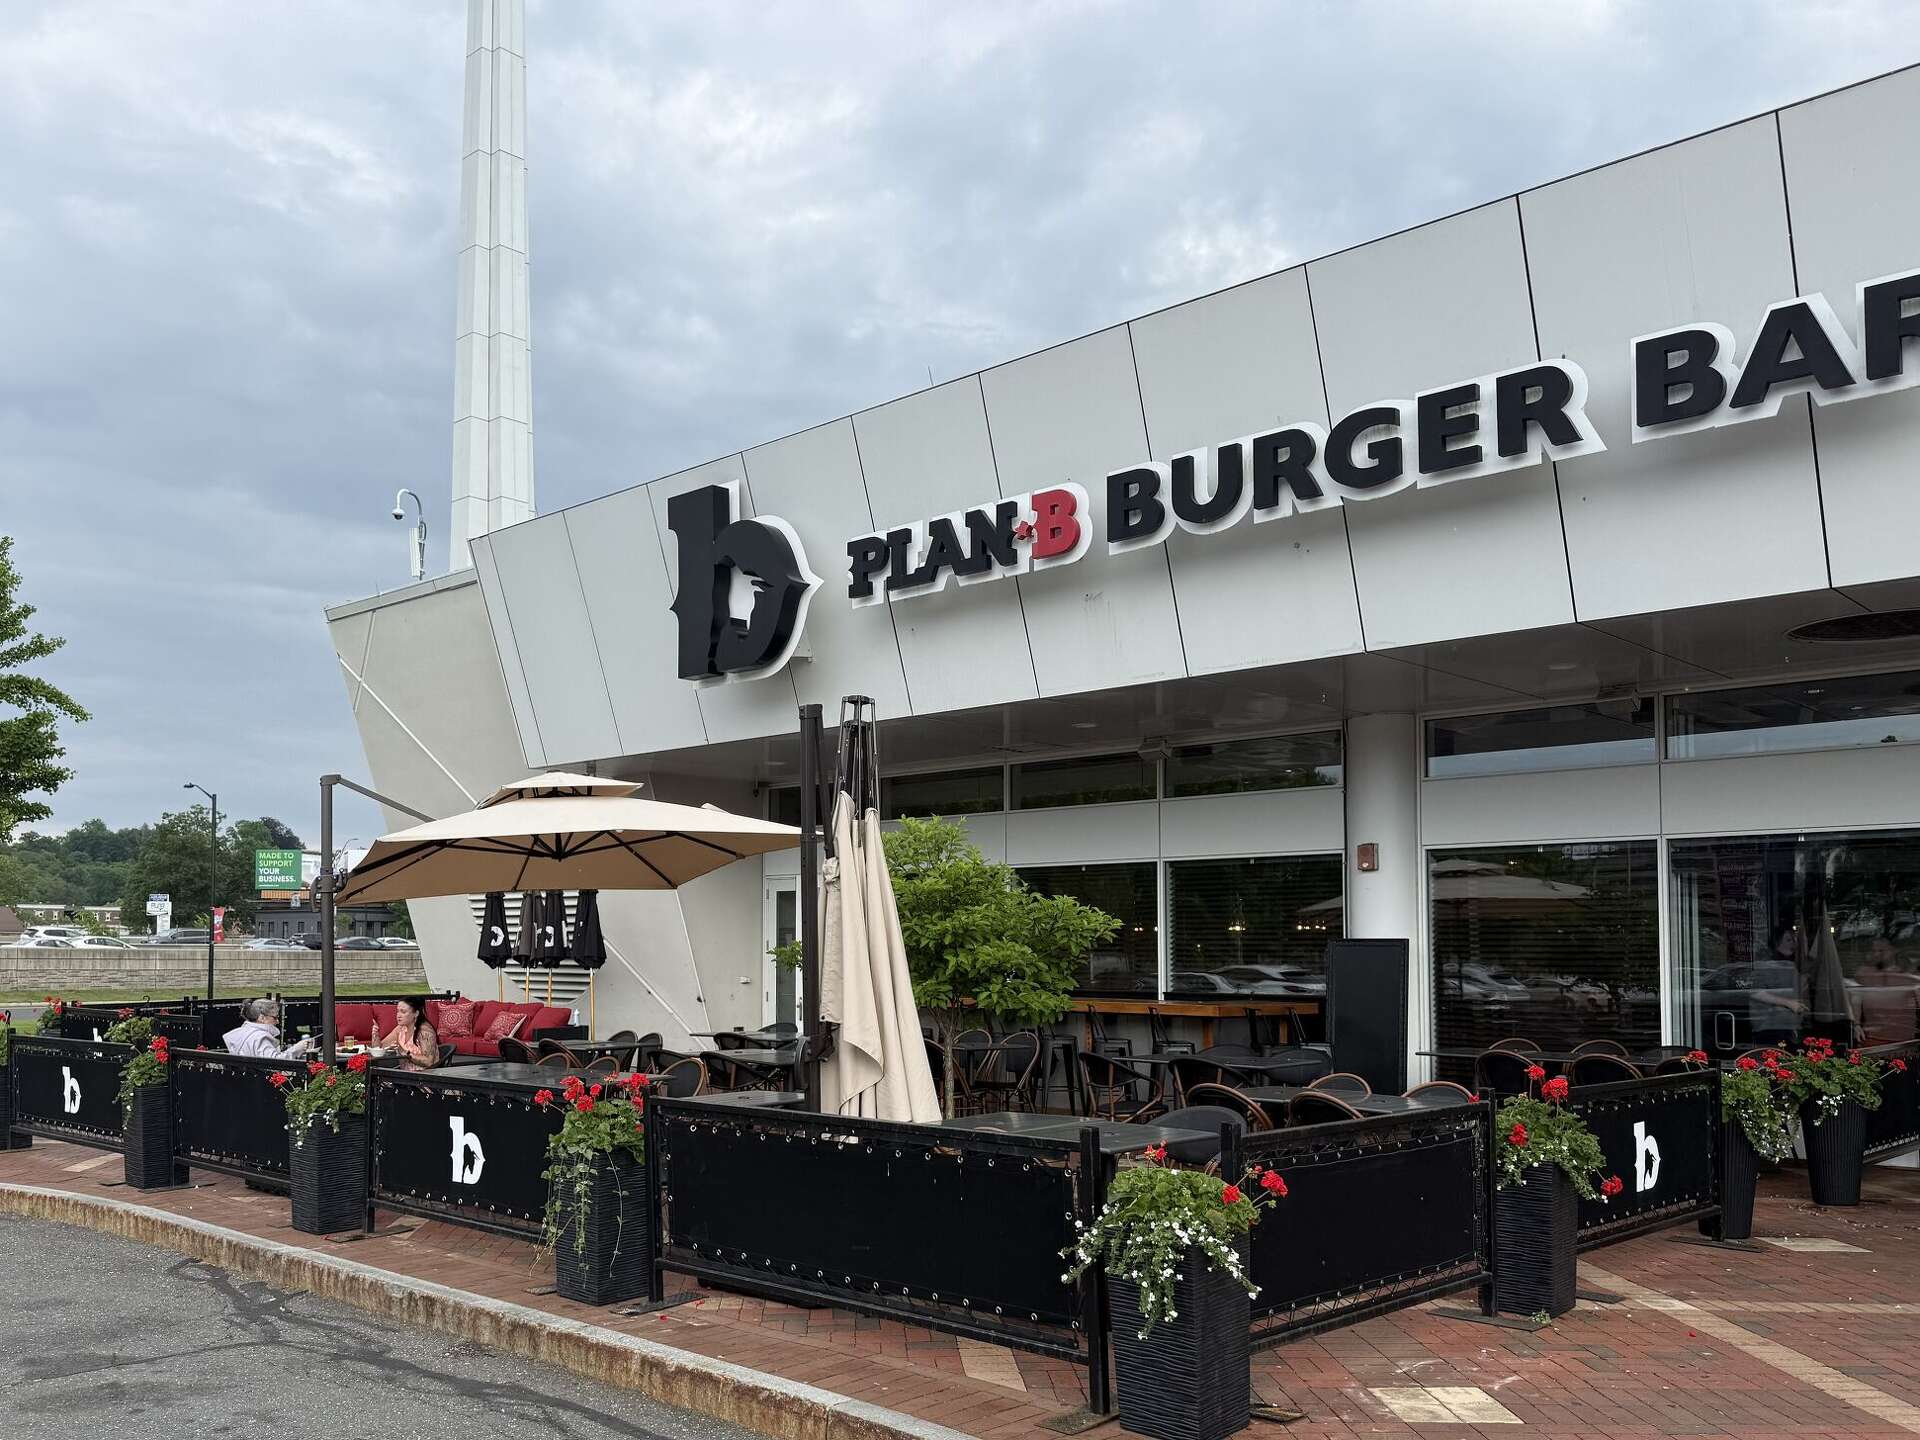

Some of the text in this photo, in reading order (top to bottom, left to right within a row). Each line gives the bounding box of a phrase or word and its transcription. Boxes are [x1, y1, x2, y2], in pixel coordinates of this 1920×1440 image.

[847, 501, 1018, 598] PLAN
[1031, 489, 1082, 560] B
[1108, 364, 1584, 543] BURGER
